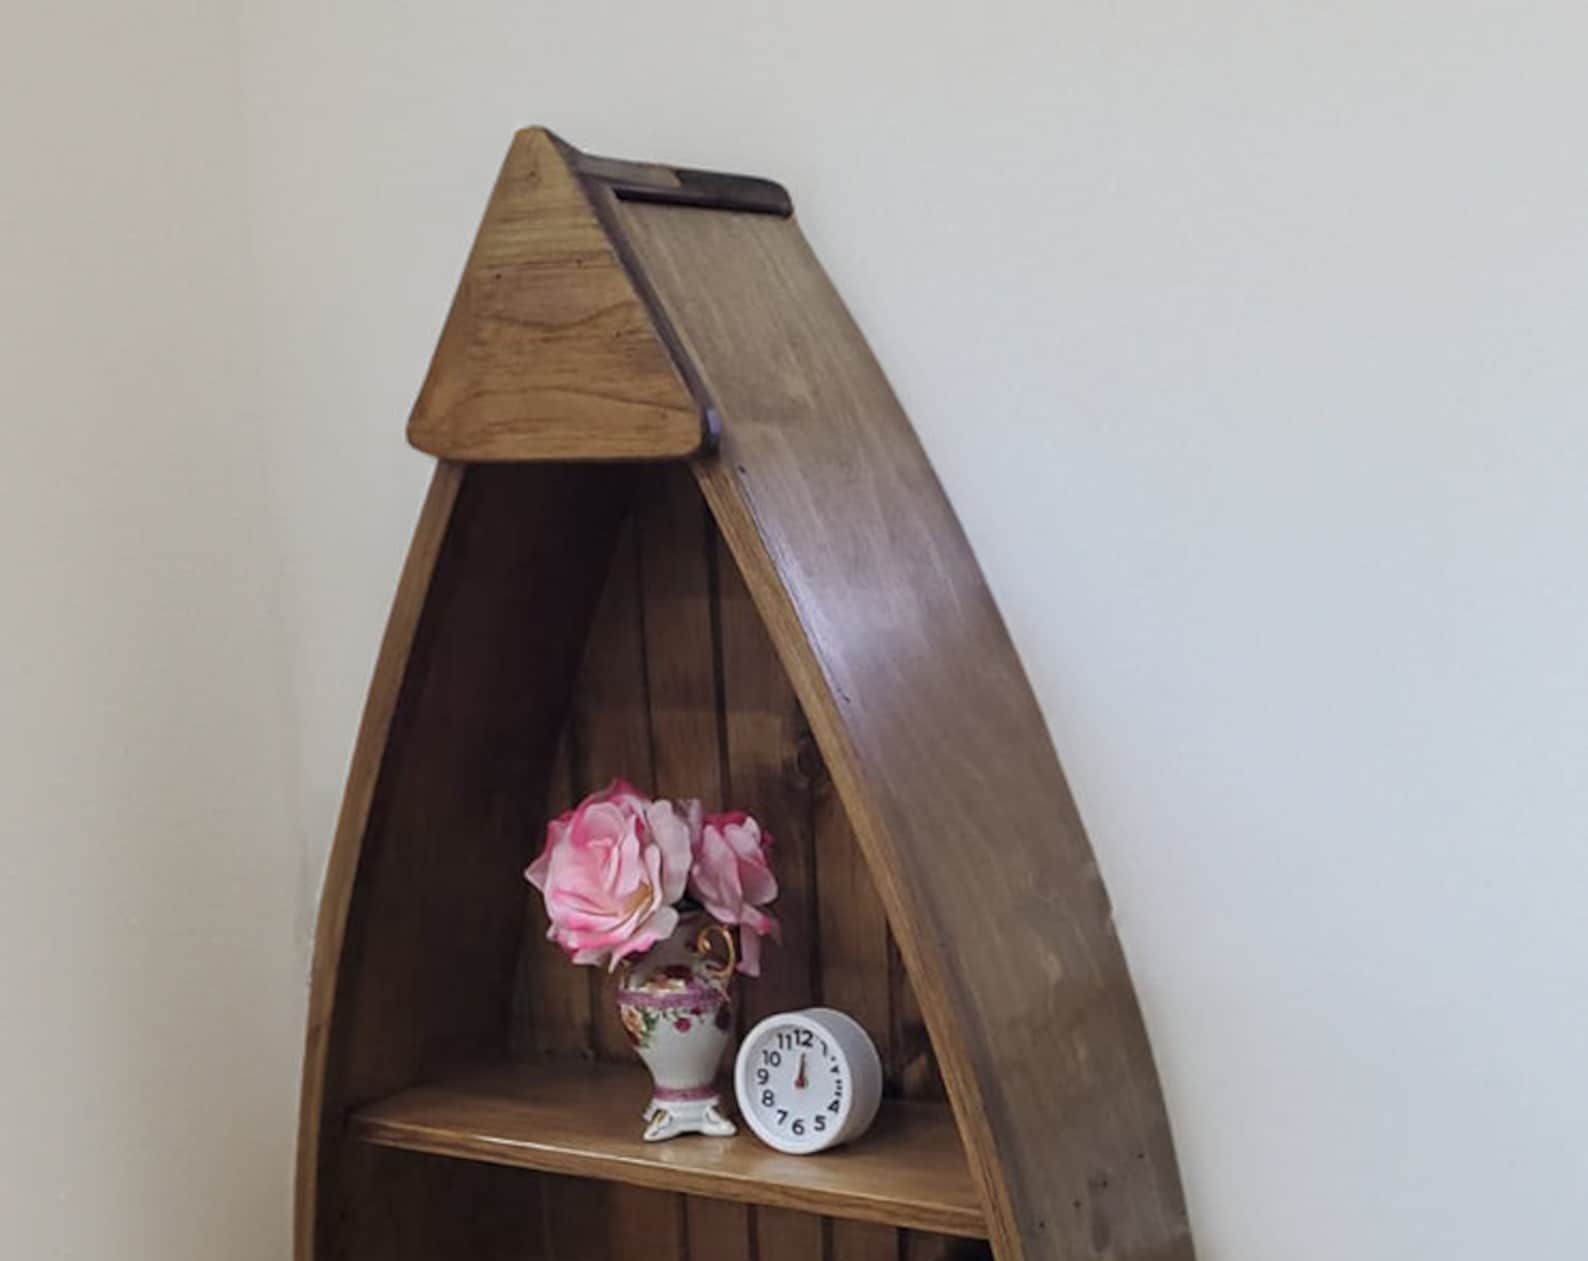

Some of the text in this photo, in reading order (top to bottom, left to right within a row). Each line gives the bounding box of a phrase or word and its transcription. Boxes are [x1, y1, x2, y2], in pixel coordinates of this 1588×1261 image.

[777, 1033, 792, 1050] 11
[793, 1029, 813, 1048] 12
[762, 1050, 781, 1067] 10
[757, 1068, 769, 1085] 9
[761, 1089, 774, 1107] 8
[777, 1109, 788, 1125] 7
[814, 1115, 826, 1131] 5
[792, 1119, 805, 1135] 6
